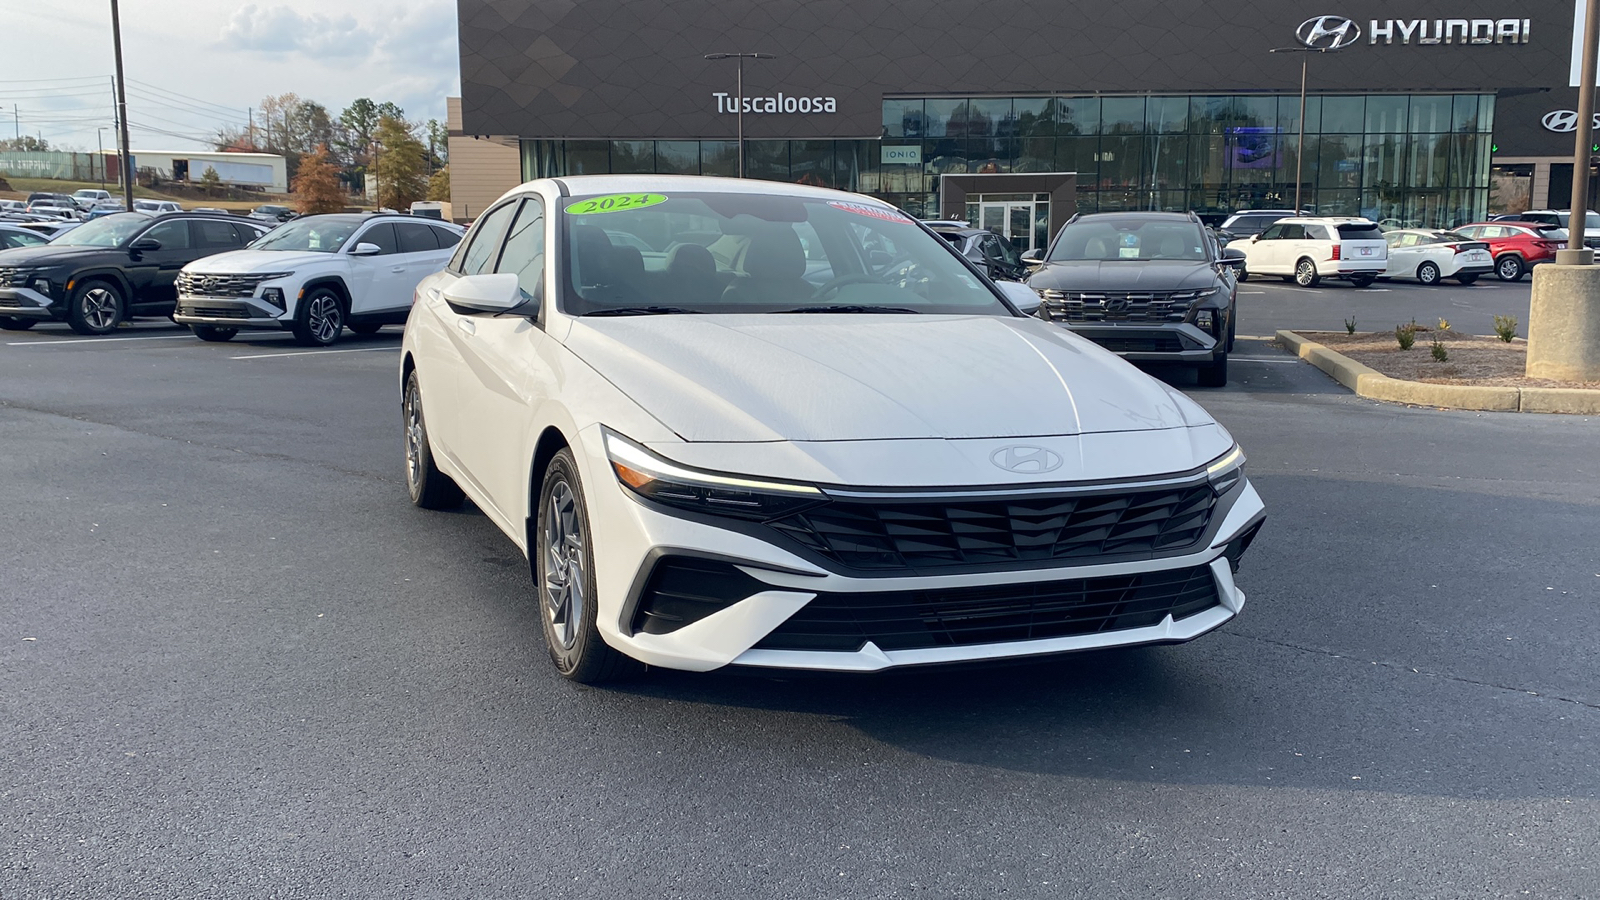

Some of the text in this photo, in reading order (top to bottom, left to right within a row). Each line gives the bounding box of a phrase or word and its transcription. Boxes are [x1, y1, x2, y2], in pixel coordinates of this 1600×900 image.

[1369, 18, 1531, 45] HYUNDAI
[712, 92, 837, 113] Tuscaloosa
[582, 194, 649, 213] 2024
